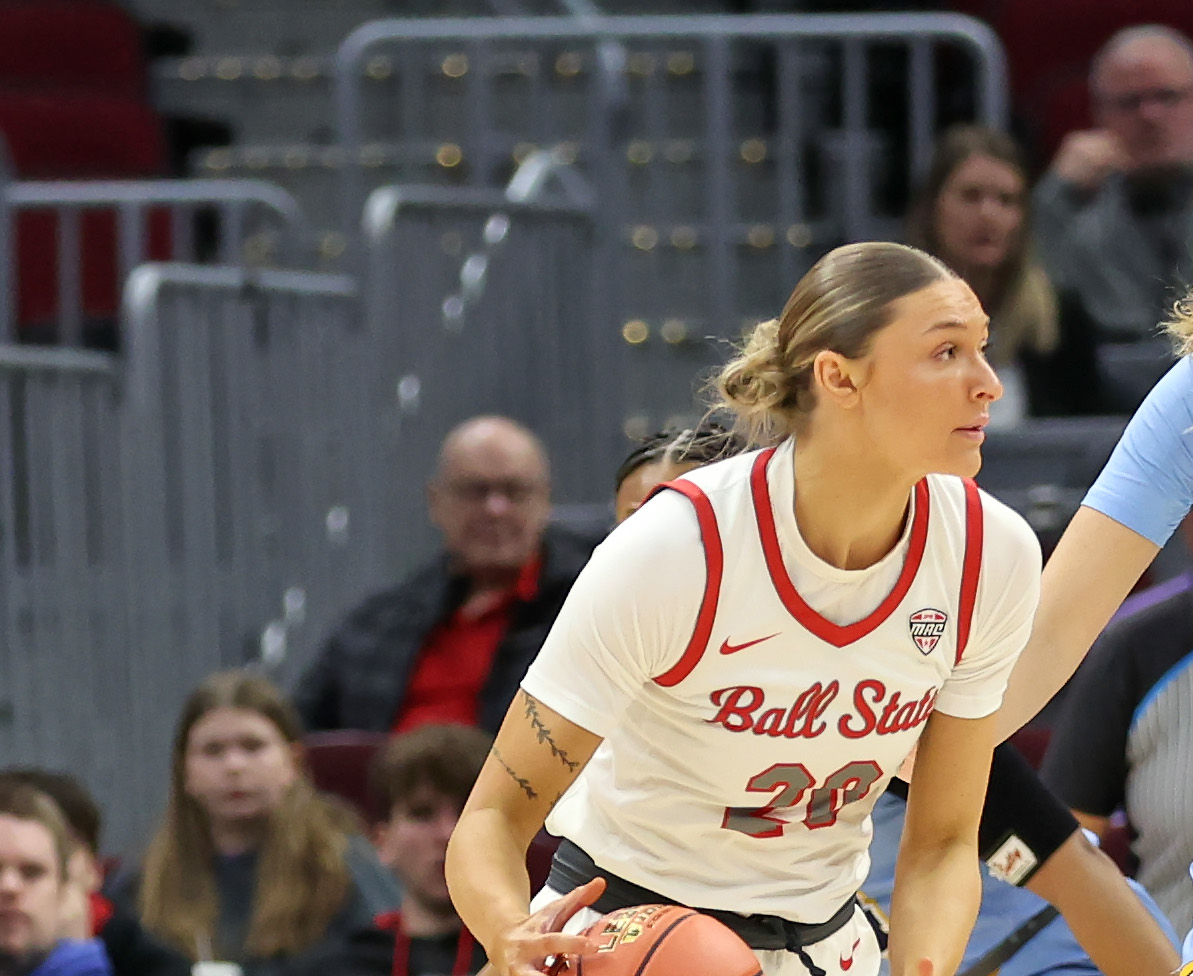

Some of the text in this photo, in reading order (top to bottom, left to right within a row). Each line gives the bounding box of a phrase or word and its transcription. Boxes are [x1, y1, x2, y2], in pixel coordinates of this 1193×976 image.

[910, 623, 945, 636] MAC
[704, 678, 938, 739] Ball Stat
[720, 760, 884, 839] 20
